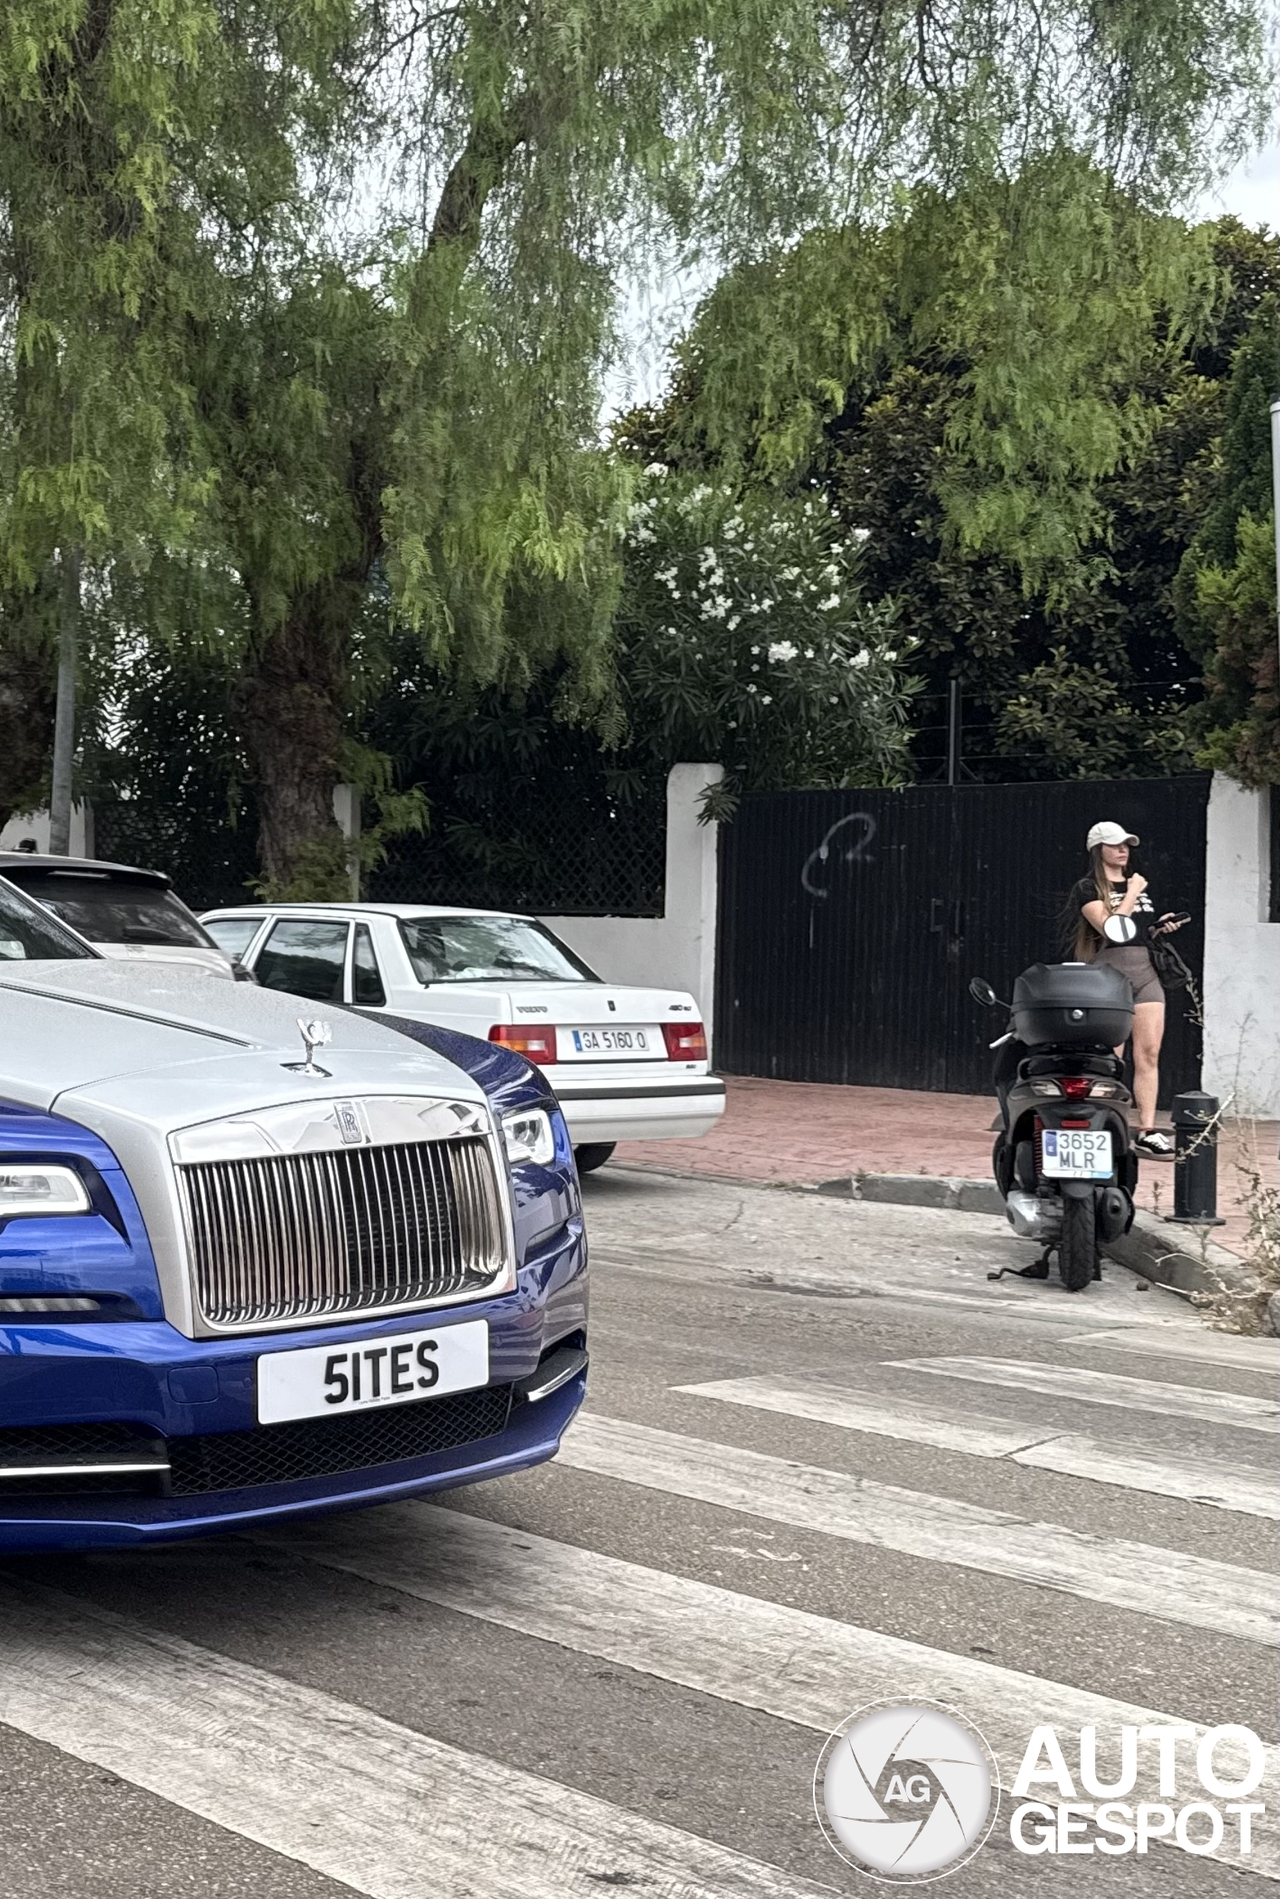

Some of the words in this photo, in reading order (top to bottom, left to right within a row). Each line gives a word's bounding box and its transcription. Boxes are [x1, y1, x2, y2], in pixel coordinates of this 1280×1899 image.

[582, 1031, 600, 1049] SA
[602, 1031, 633, 1049] 5160
[1059, 1133, 1107, 1151] 3652
[1059, 1151, 1095, 1169] MLR
